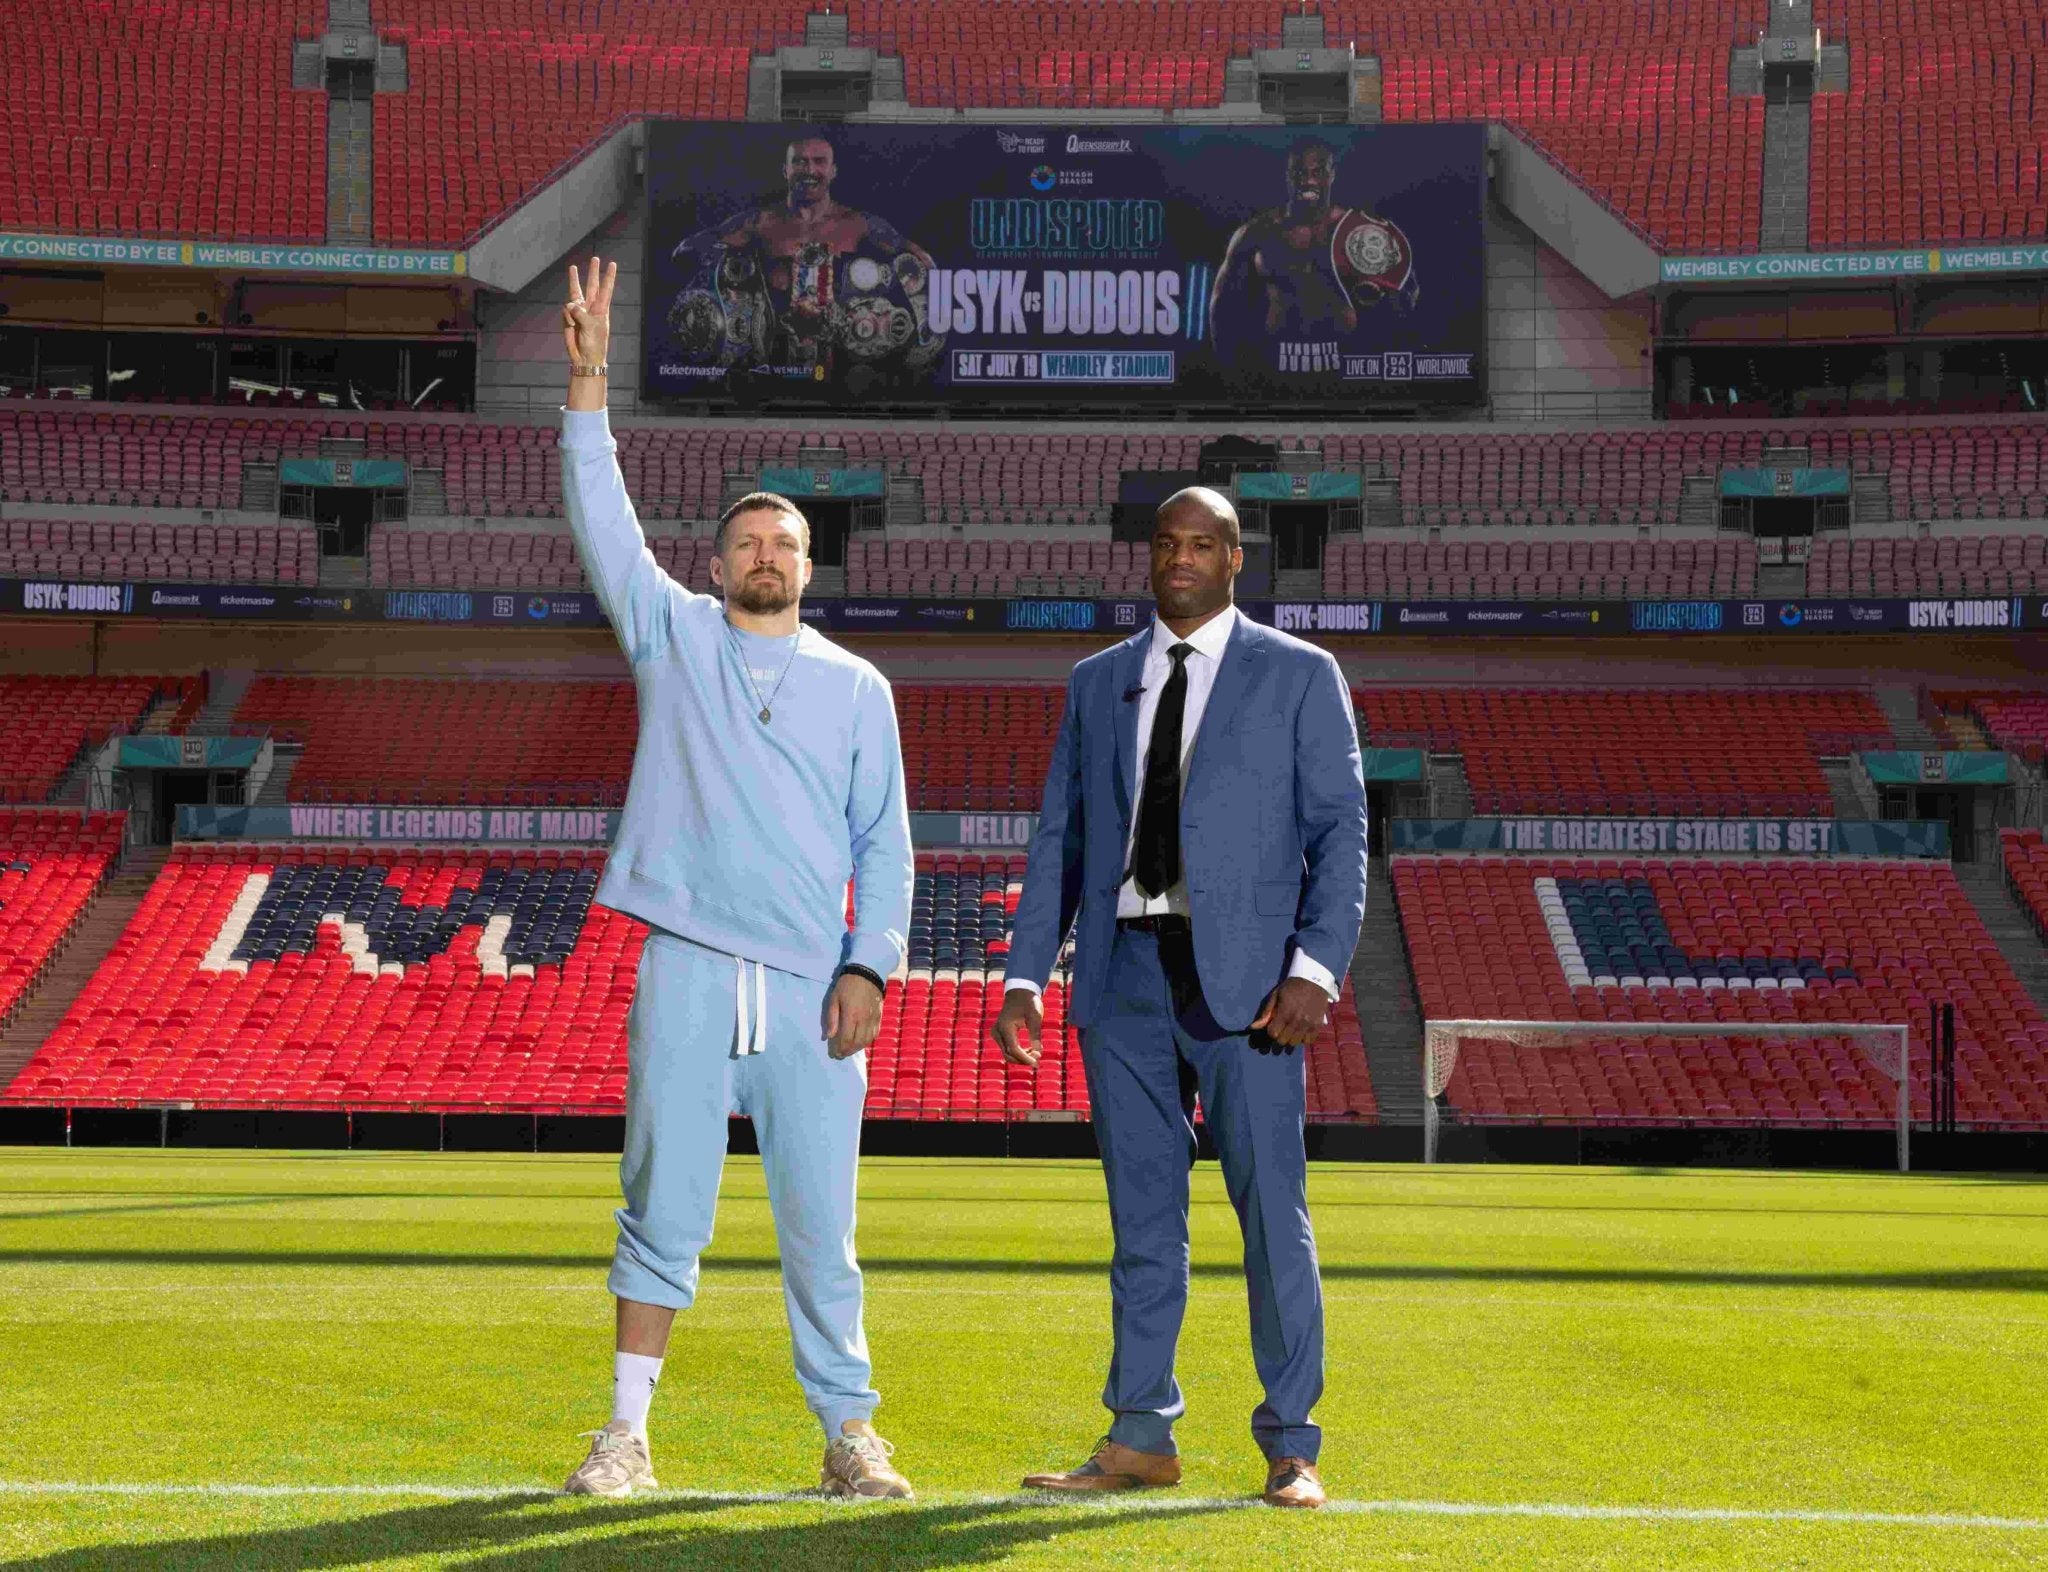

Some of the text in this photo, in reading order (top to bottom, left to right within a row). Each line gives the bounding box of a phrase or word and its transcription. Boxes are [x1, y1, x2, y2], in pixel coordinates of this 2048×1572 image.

[971, 199, 1164, 250] UNDISPUTED
[13, 241, 126, 258] CONNECTED
[131, 244, 151, 259] BY
[157, 245, 177, 260] EE
[199, 249, 449, 270] WEMBLEY CONNECTED BY EE
[1946, 251, 2036, 268] WEMBLEY
[1665, 256, 1923, 276] WEMBLEY CONNECTED BY EE
[928, 269, 1028, 335] USYK
[1043, 269, 1180, 335] DUBOIS
[660, 364, 814, 378] ticketmaster WEMBLEY
[959, 354, 1170, 377] SAT JULY 19 WEMBLEY STADIUM
[1346, 359, 1380, 375] LIVE ON
[1416, 358, 1470, 375] WORLDWIDE
[24, 583, 63, 609] USYK
[68, 584, 121, 611] DUBOIS
[220, 595, 275, 606] ticketmaster
[844, 607, 900, 617] ticketmaster
[1275, 604, 1312, 629] USYK
[1317, 604, 1369, 630] DUBOIS
[1467, 611, 1522, 621] ticketmaster
[1909, 601, 1949, 627] USYK
[1954, 600, 2009, 627] DUBOIS
[185, 742, 202, 754] 110
[1925, 756, 1942, 768] 113
[290, 807, 608, 840] WHERE LEGENDS ARE MADE
[960, 815, 1029, 844] HELLO
[1501, 820, 1832, 851] THE GREATEST STAGE IS SET
